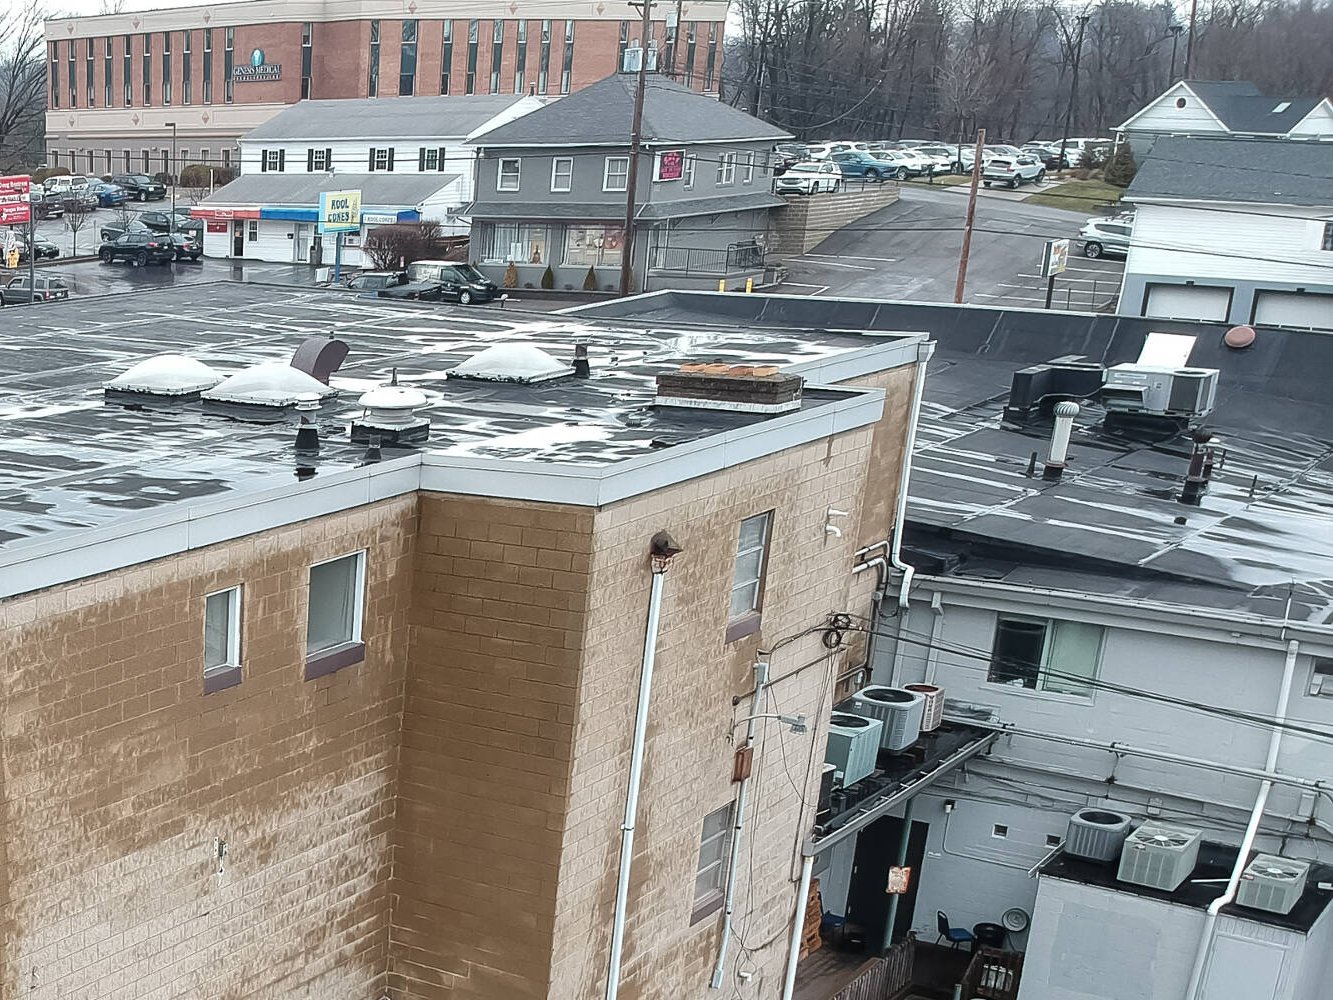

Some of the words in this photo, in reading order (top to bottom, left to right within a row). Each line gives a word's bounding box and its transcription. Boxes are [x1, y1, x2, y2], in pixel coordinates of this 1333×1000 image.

[234, 66, 254, 75] GENESIS
[256, 64, 280, 74] MEDICAL
[331, 198, 349, 210] KOOL
[328, 211, 349, 222] CONES
